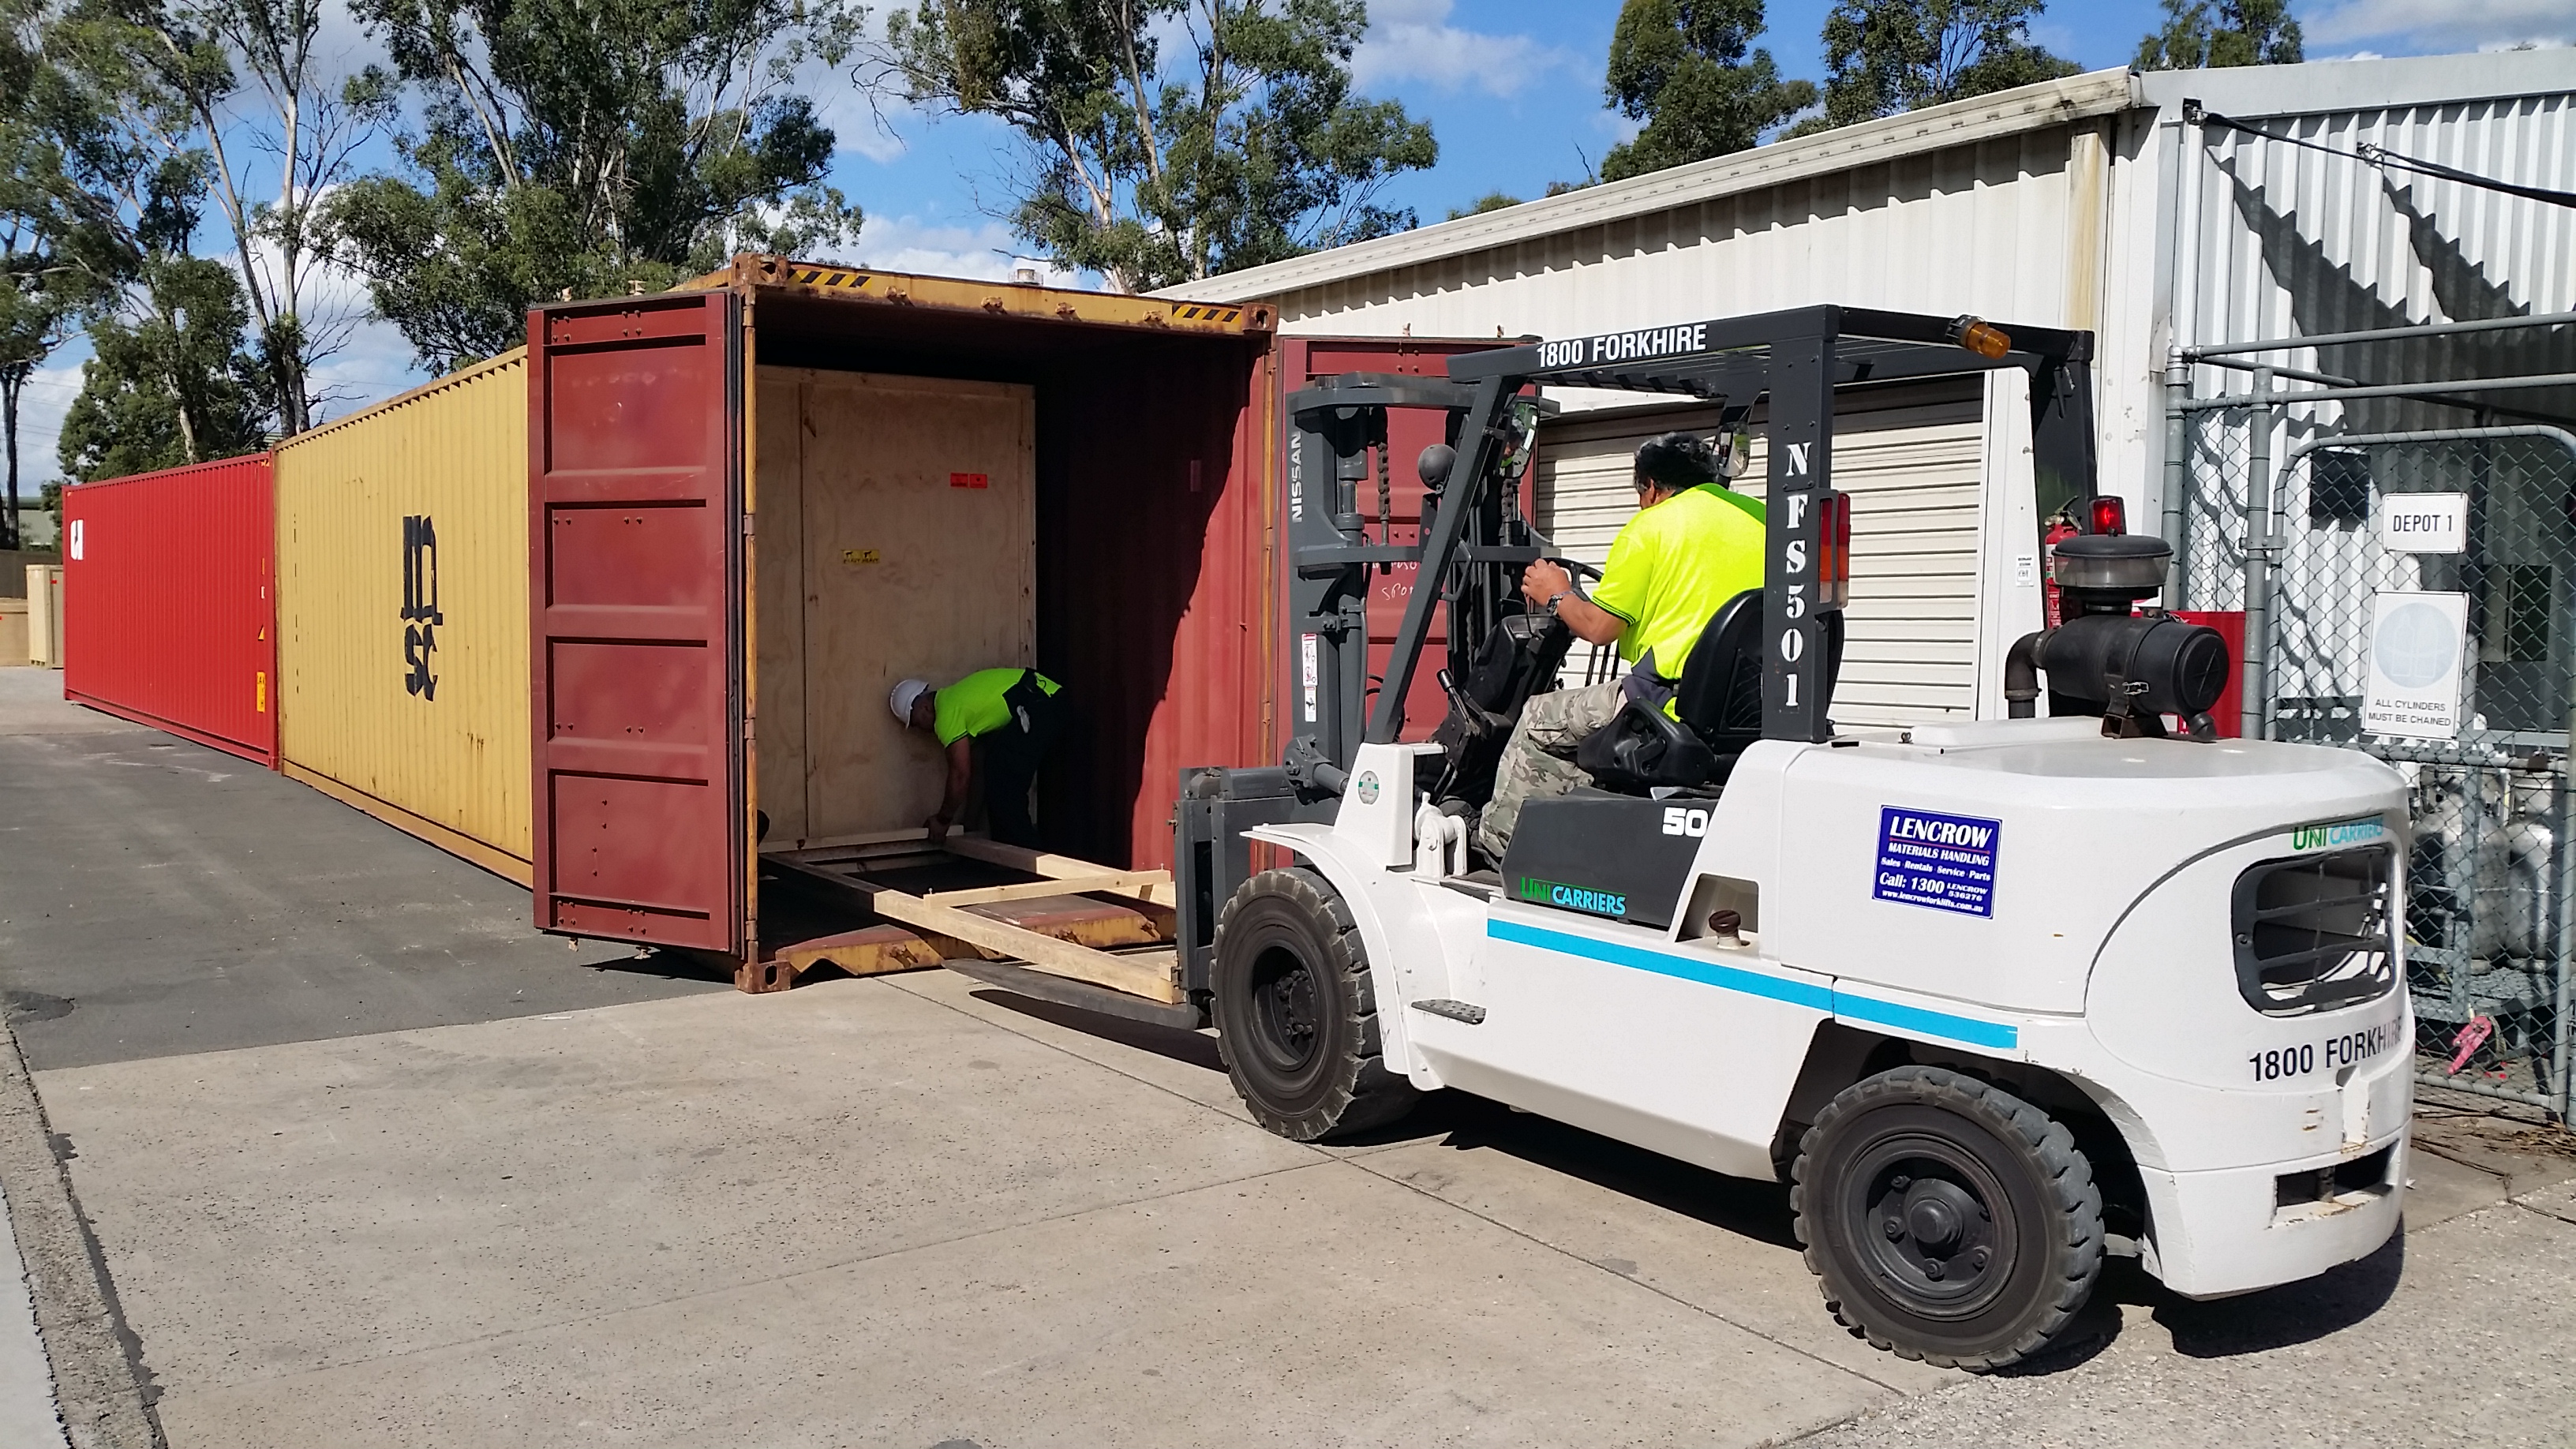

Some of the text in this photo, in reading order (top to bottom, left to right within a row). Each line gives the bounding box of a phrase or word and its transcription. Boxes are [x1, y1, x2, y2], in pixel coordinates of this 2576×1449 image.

[1537, 324, 1707, 368] 1800 FORKHIRE
[1291, 431, 1302, 522] NISSAN
[2393, 515, 2452, 532] DEPOT 1
[1780, 442, 1812, 706] NFS501
[2376, 698, 2446, 711] ALL CYLINDERS
[2368, 713, 2451, 726] MUST BE CHAINED
[1662, 807, 1709, 837] 50
[1889, 816, 1993, 848] LENCROW
[1888, 842, 1990, 866] MATERIALS HANDLING
[1881, 857, 1990, 882] Sales Rentals Service Parts
[1880, 872, 1988, 894] Call: 1300 LENCROW
[1881, 889, 1983, 912] www.lencrowforklifts.com.au
[1948, 890, 1983, 901] 536276
[2249, 1044, 2313, 1082] 1800
